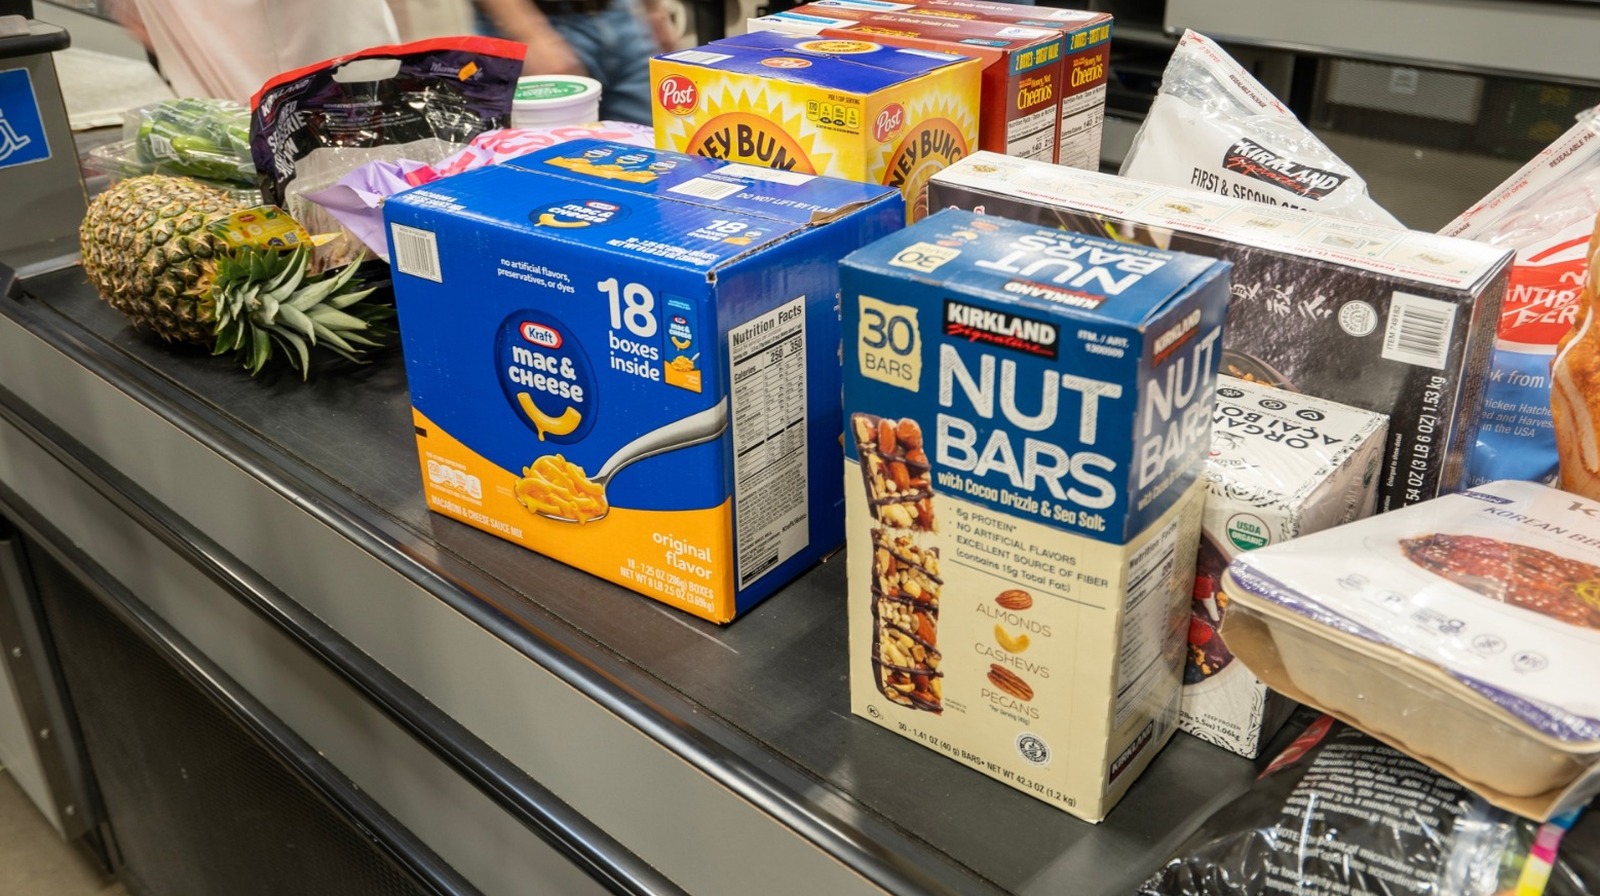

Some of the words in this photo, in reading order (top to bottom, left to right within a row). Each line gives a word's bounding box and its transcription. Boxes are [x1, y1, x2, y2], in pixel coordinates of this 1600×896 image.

[1071, 63, 1104, 88] Cheerios
[662, 79, 695, 107] Post
[1017, 83, 1053, 110] Cheerios
[877, 109, 902, 138] Post
[1234, 138, 1340, 191] KIRKLAND
[1549, 139, 1584, 168] RESEALABLE
[1191, 167, 1219, 193] FIRST
[1220, 179, 1229, 197] &
[737, 192, 755, 200] DO
[752, 194, 776, 204] NOT
[773, 198, 797, 208] LIFT
[706, 219, 748, 234] 18
[1009, 233, 1168, 276] BARS
[497, 268, 548, 288] preservatives,
[547, 280, 557, 288] or
[556, 282, 575, 294] dyes
[501, 258, 511, 267] no
[511, 258, 541, 276] artificial
[541, 265, 571, 283] flavors,
[975, 251, 1143, 296] NUT
[597, 277, 658, 338] 18
[1003, 281, 1099, 309] KIRKLAND
[528, 326, 555, 344] Kraft
[733, 317, 775, 346] Nutrition
[778, 304, 802, 324] Facts
[863, 308, 914, 357] 30
[948, 302, 1057, 347] KIRKLAND
[609, 330, 659, 361] boxes
[770, 347, 784, 362] 250
[790, 337, 803, 352] 350
[945, 323, 1055, 357] Signature
[512, 345, 558, 375] mac
[560, 357, 577, 381] &
[610, 351, 660, 382] inside
[865, 355, 914, 382] BARS
[1143, 325, 1221, 434] NUT
[1427, 376, 1445, 389] kg
[1507, 369, 1545, 389] from
[938, 342, 1122, 446] NUT
[1422, 391, 1439, 412] 1.53
[1417, 414, 1436, 434] OZ)
[1482, 423, 1492, 432] in
[1494, 424, 1512, 435] the
[1513, 426, 1537, 438] USA
[1495, 412, 1517, 423] and
[936, 411, 1117, 510] BARS
[1411, 460, 1427, 470] (3
[1414, 444, 1429, 458] LB
[1387, 466, 1396, 486] Enlarged
[1409, 472, 1423, 486] OZ
[937, 471, 962, 488] with
[965, 479, 998, 500] Cocoa
[1000, 485, 1039, 516] Drizzle
[1040, 502, 1051, 516] &
[1053, 505, 1077, 524] Sea
[1079, 511, 1107, 533] Salt
[1406, 489, 1421, 501] 54
[957, 509, 969, 522] 6g
[1236, 520, 1261, 535] USDA
[1483, 506, 1568, 534] KOREAN
[653, 532, 712, 563] original
[957, 521, 971, 534] NO
[973, 525, 1027, 552] ARTIFICIAL
[1029, 543, 1077, 566] FLAVORS
[620, 566, 634, 580] NET
[635, 571, 647, 584] WT
[655, 568, 666, 581] OZ
[665, 550, 712, 581] flavor
[956, 549, 1000, 570] (contains
[1002, 563, 1018, 578] 15g
[1021, 568, 1047, 585] Total
[1049, 578, 1071, 593] Fat)
[957, 535, 1011, 560] EXCELLENT
[1014, 553, 1055, 575] SOURCE
[1058, 566, 1073, 578] OF
[1077, 571, 1109, 588] FIBER
[976, 602, 1052, 638] ALMONDS
[974, 642, 1050, 679] CASHEWS
[981, 688, 1041, 720] PECANS
[898, 721, 907, 732] 30
[913, 726, 927, 740] 1.41
[928, 734, 939, 745] OZ
[940, 739, 952, 753] (40
[987, 759, 1001, 773] NET
[1003, 766, 1015, 779] WT
[1016, 772, 1033, 787] 42.3
[1034, 780, 1044, 793] OZ
[1046, 784, 1061, 801] (1.2
[1063, 793, 1076, 808] kg)
